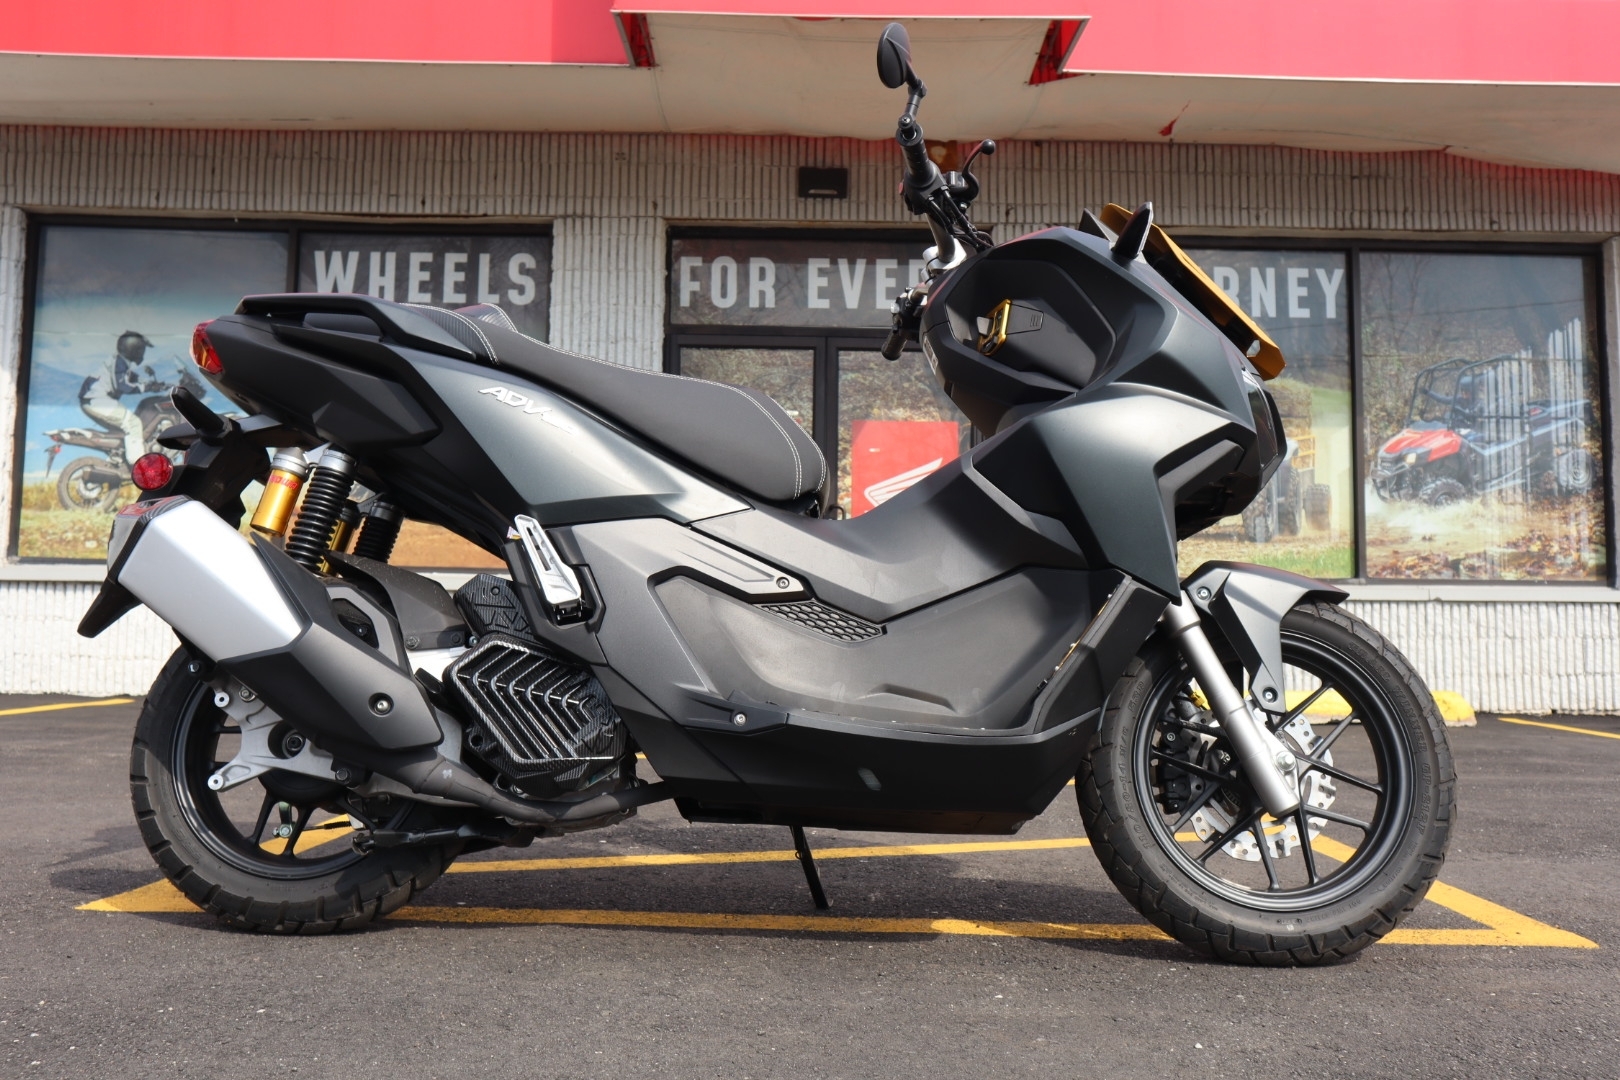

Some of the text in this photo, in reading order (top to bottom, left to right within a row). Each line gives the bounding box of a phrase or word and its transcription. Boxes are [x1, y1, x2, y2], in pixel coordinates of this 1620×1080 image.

[314, 250, 537, 306] WHEELS
[679, 255, 776, 309] FOR
[478, 386, 553, 414] ADV
